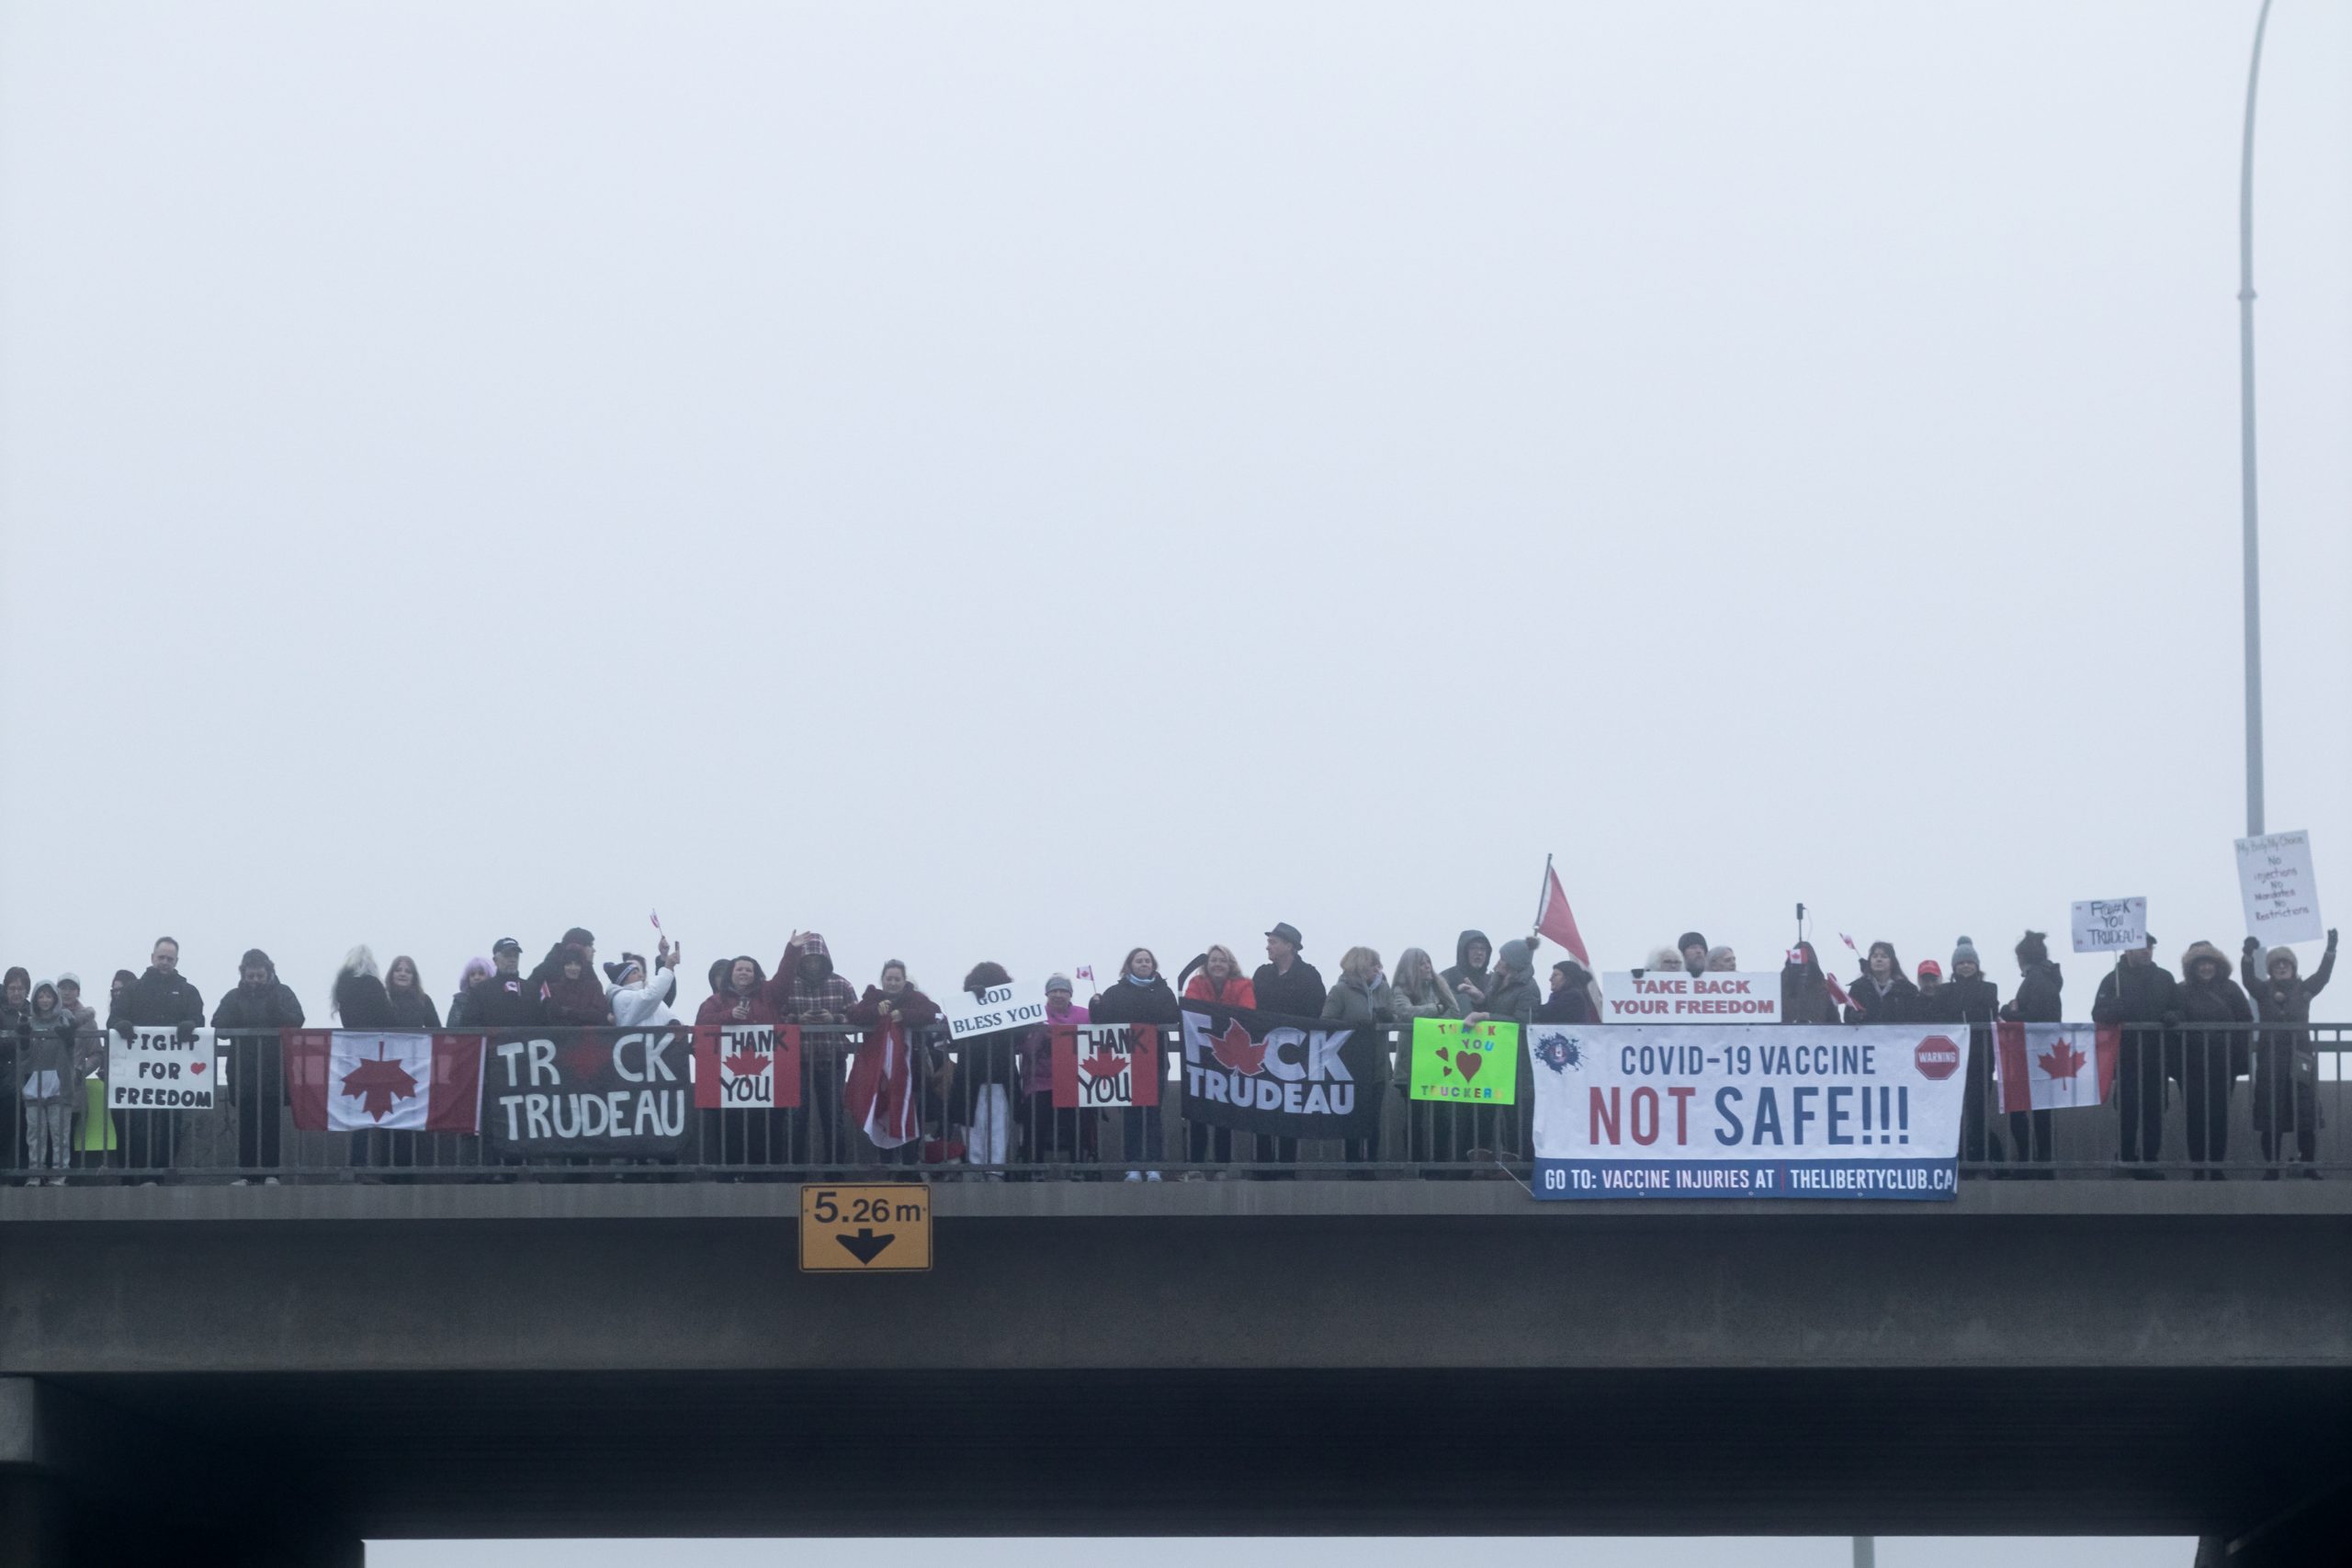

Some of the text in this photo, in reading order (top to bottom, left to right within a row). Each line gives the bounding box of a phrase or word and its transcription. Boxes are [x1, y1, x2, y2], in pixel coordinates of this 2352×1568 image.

[2101, 915, 2124, 928] YOU
[1632, 980, 1751, 995] TAKE BACK
[953, 1004, 1043, 1034] BLESS YOU
[1611, 999, 1775, 1014] YOUR FREEDOM
[704, 1030, 789, 1055] THANK
[1060, 1028, 1148, 1055] THANK
[1462, 1038, 1496, 1052] YOU
[1621, 1045, 1876, 1076] COVID-19 VACCINE
[1918, 1051, 1956, 1064] WARNING
[139, 1062, 182, 1080] FOR
[115, 1087, 212, 1108] FREEDOM
[719, 1076, 772, 1102] YOU
[1076, 1071, 1133, 1105] YOU
[1186, 1064, 1356, 1115] TRUDEAU
[499, 1089, 685, 1141] TRUDEAU
[1589, 1086, 1909, 1146] NOT SAFE!!!
[1544, 1168, 1953, 1190] GO TO: VACCINE INJURIES AT THELIBERTYCLUB.CA
